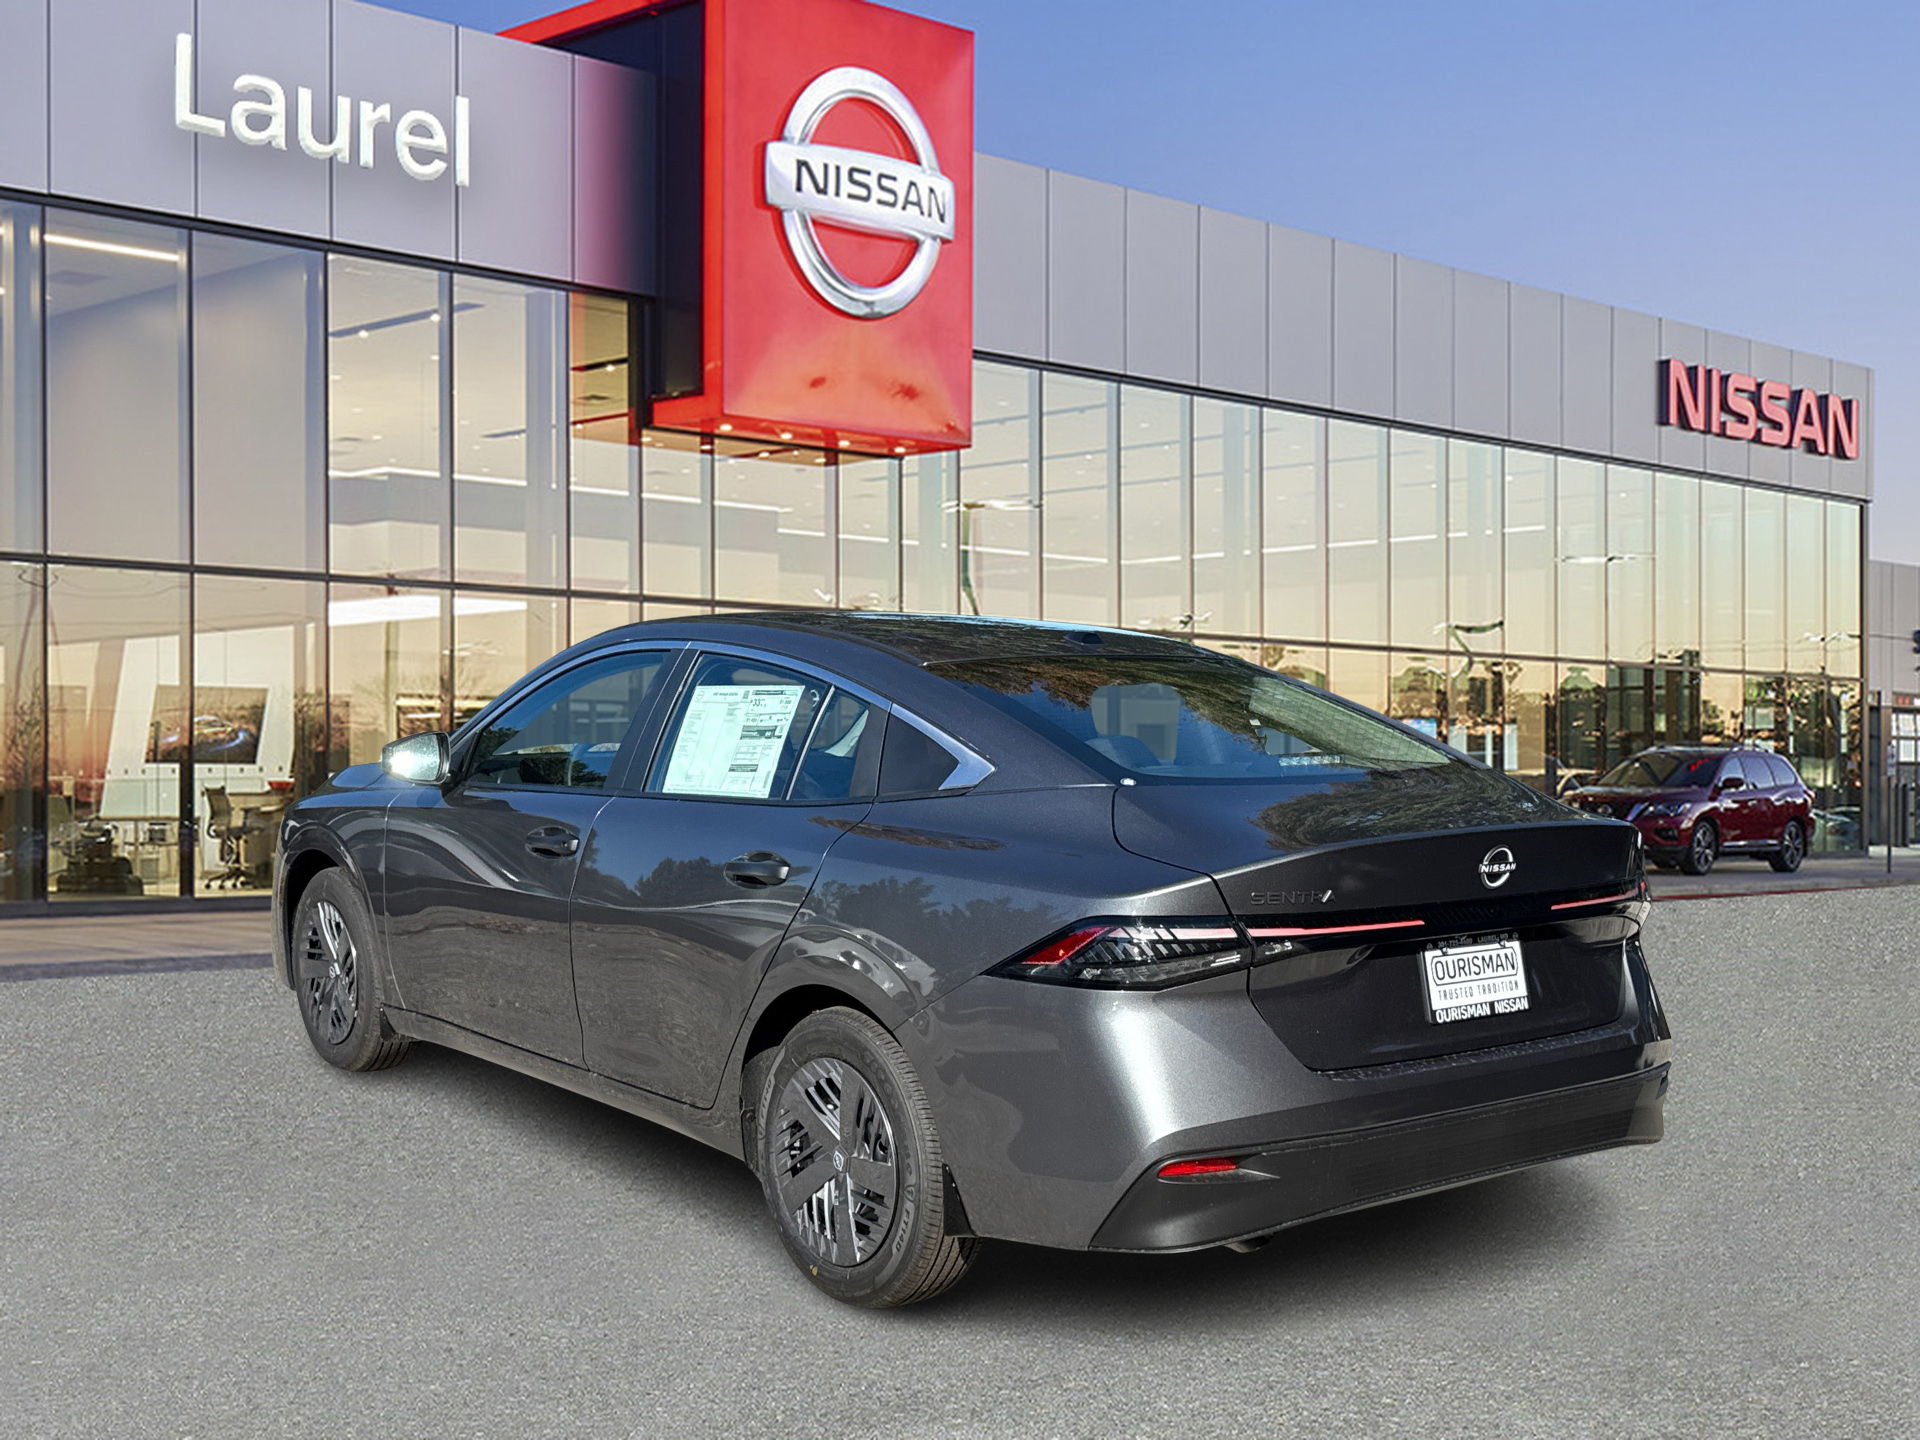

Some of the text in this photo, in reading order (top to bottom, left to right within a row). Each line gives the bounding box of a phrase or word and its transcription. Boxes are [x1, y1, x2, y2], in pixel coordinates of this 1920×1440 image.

[175, 32, 469, 187] Laurel
[795, 158, 946, 223] NISSAN
[1662, 358, 1859, 460] NISSAN
[1480, 862, 1517, 873] NISSAN
[1250, 889, 1336, 905] SENTRA
[1434, 952, 1515, 981] OURISMAN
[1438, 979, 1519, 1001] TRUSTED TRADITION
[1435, 996, 1529, 1023] OURISMAN NISSAN
